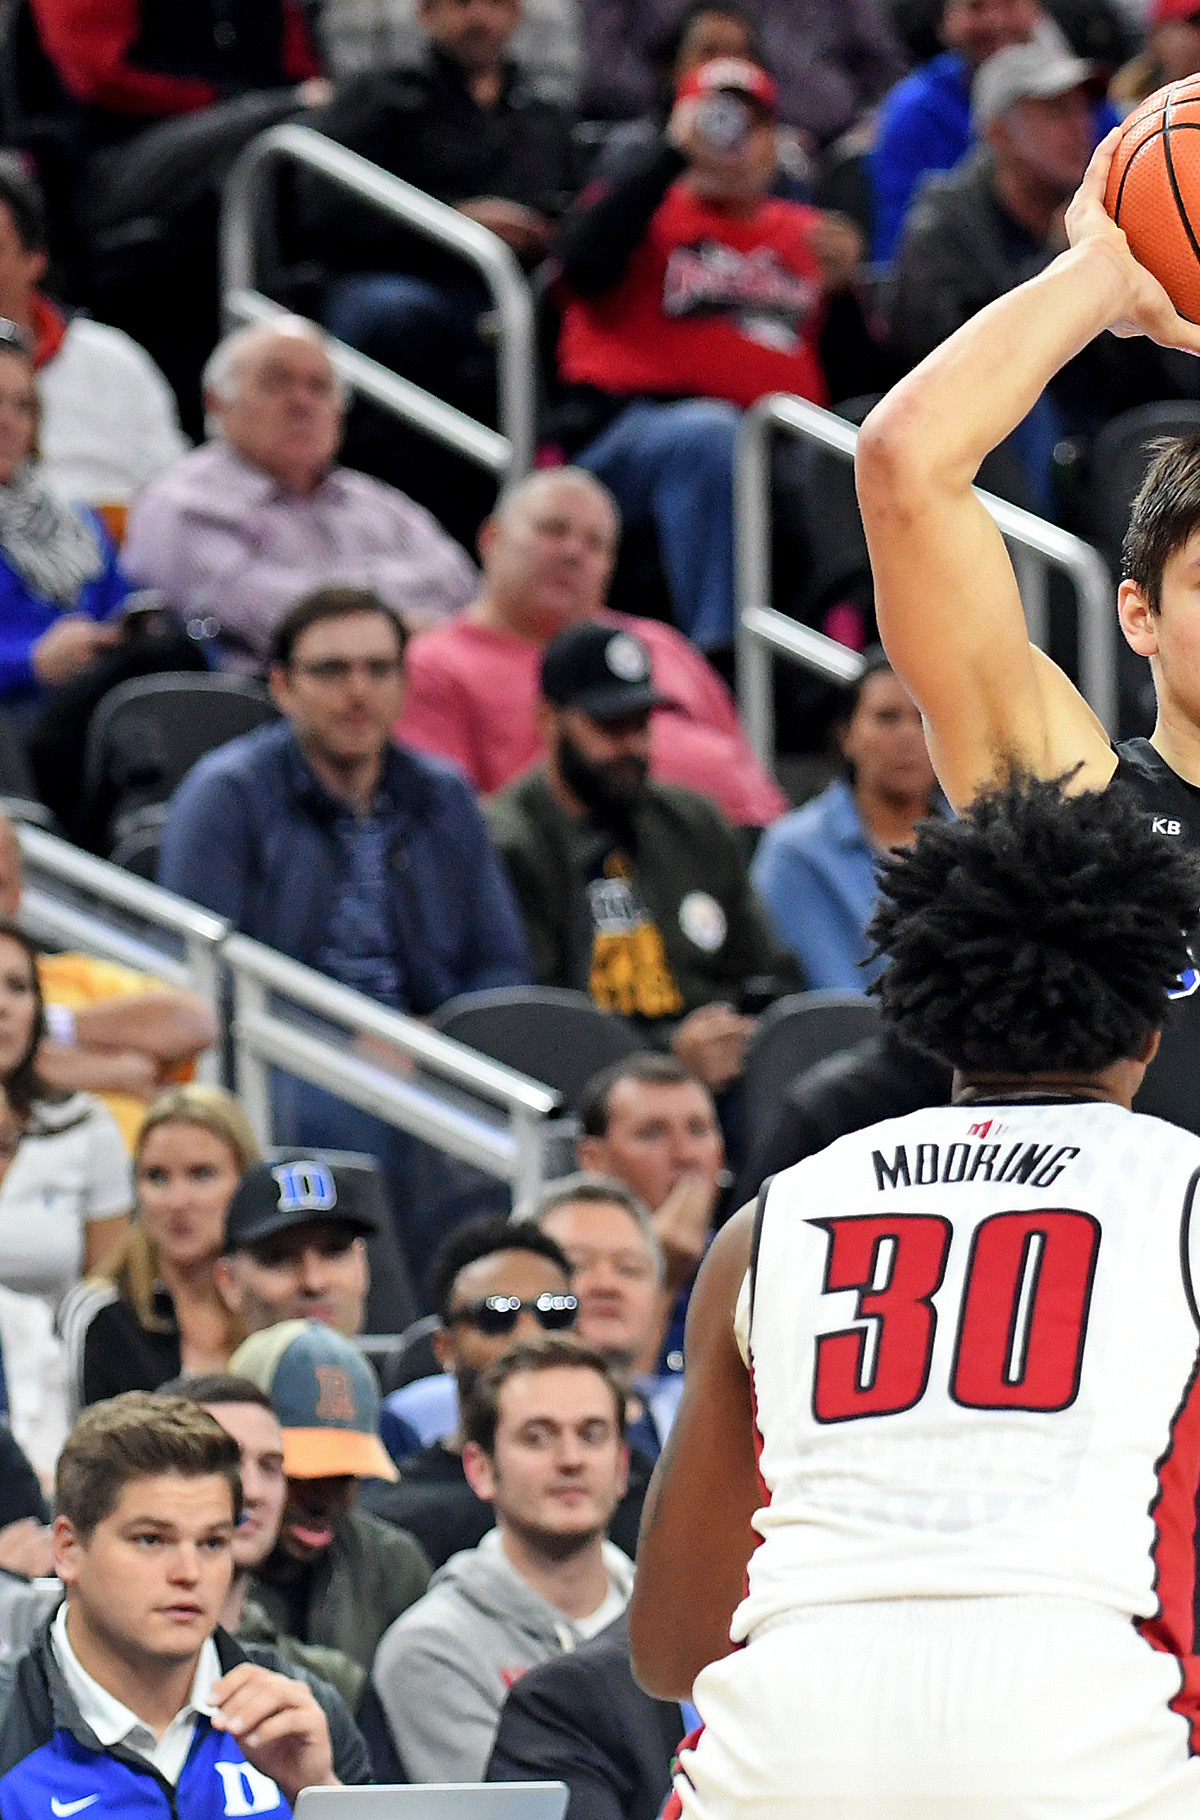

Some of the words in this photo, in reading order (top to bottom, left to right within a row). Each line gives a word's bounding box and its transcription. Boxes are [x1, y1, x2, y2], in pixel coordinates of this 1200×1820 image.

[1152, 816, 1181, 835] KB
[871, 1142, 1081, 1191] MOORING
[802, 1207, 1102, 1425] 30
[214, 1761, 281, 1817] D
